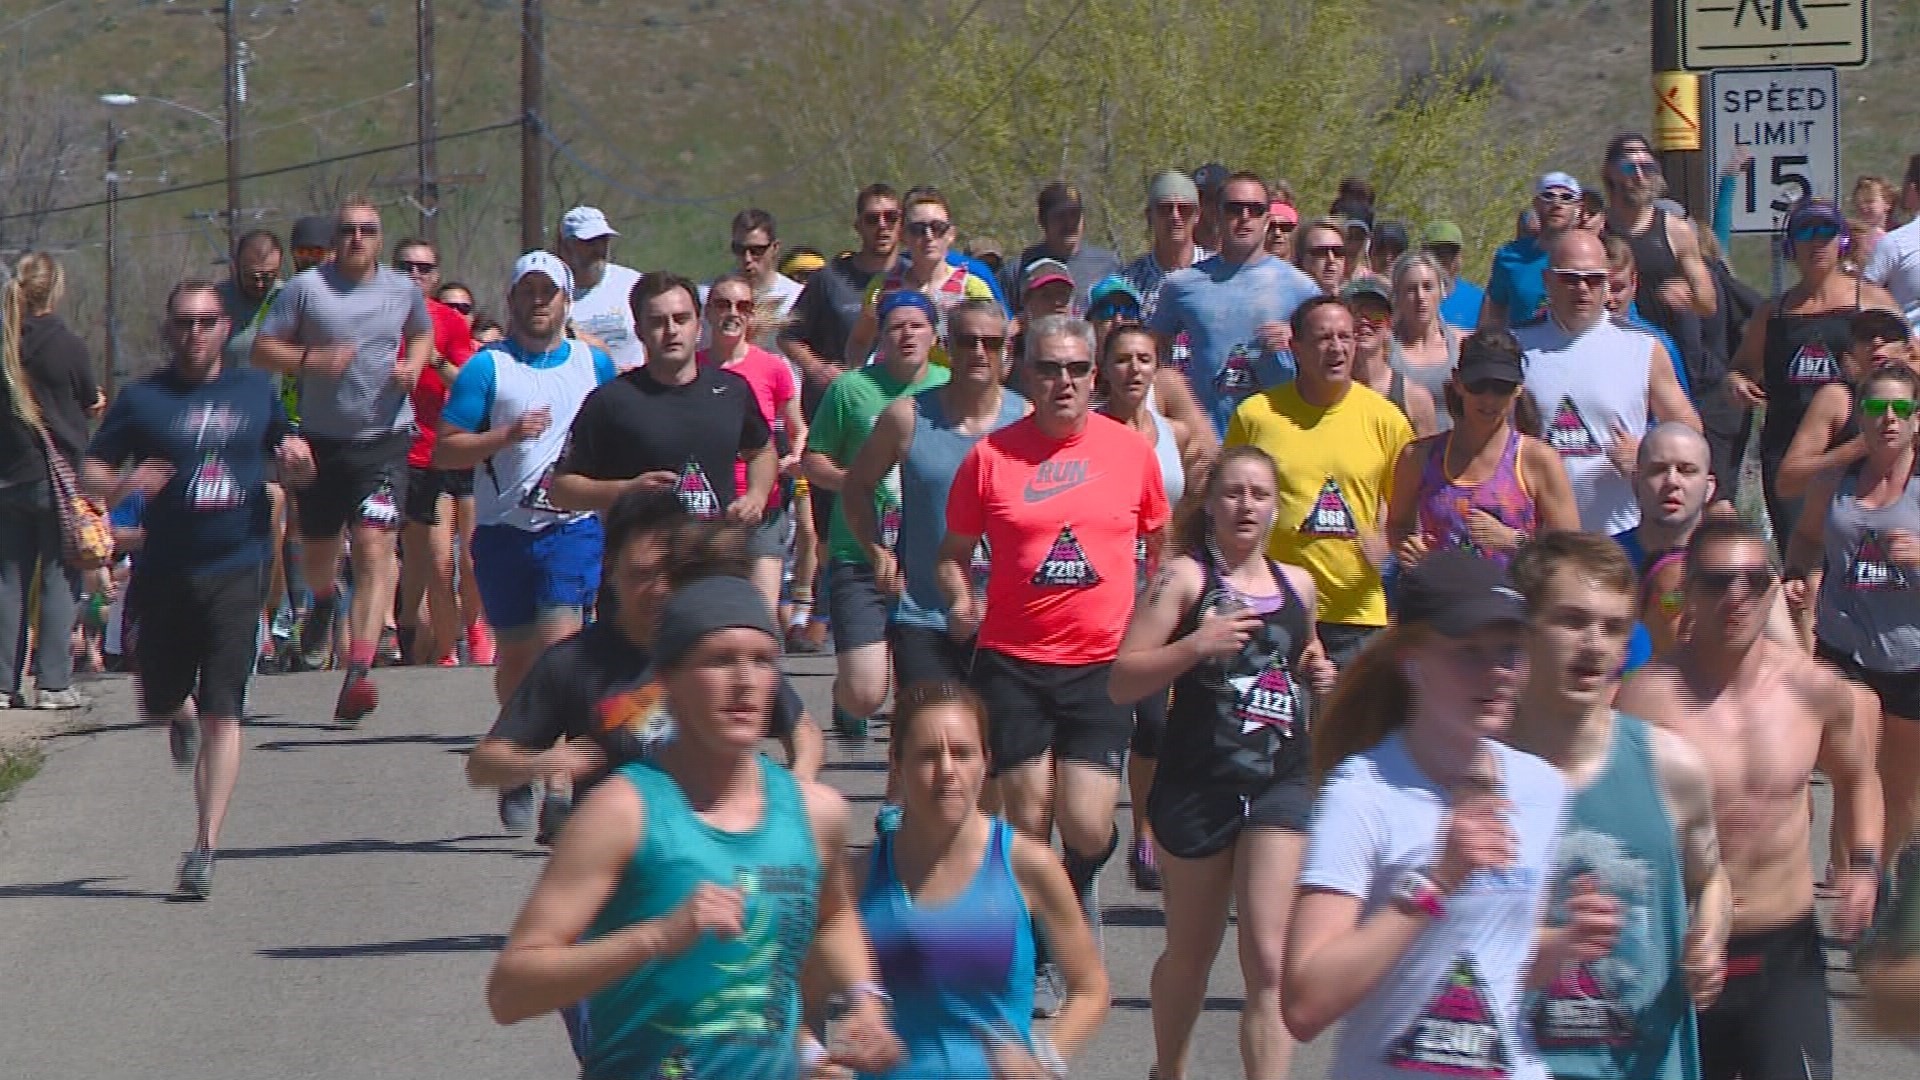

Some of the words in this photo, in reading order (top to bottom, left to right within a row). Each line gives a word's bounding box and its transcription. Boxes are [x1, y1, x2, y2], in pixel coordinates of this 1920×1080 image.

[1724, 87, 1827, 113] SPEED
[1734, 120, 1815, 146] LIMIT
[1740, 155, 1813, 214] 15
[1036, 460, 1090, 482] RUN
[1318, 509, 1345, 525] 668
[1045, 560, 1086, 578] 2203
[1251, 687, 1293, 713] 1121
